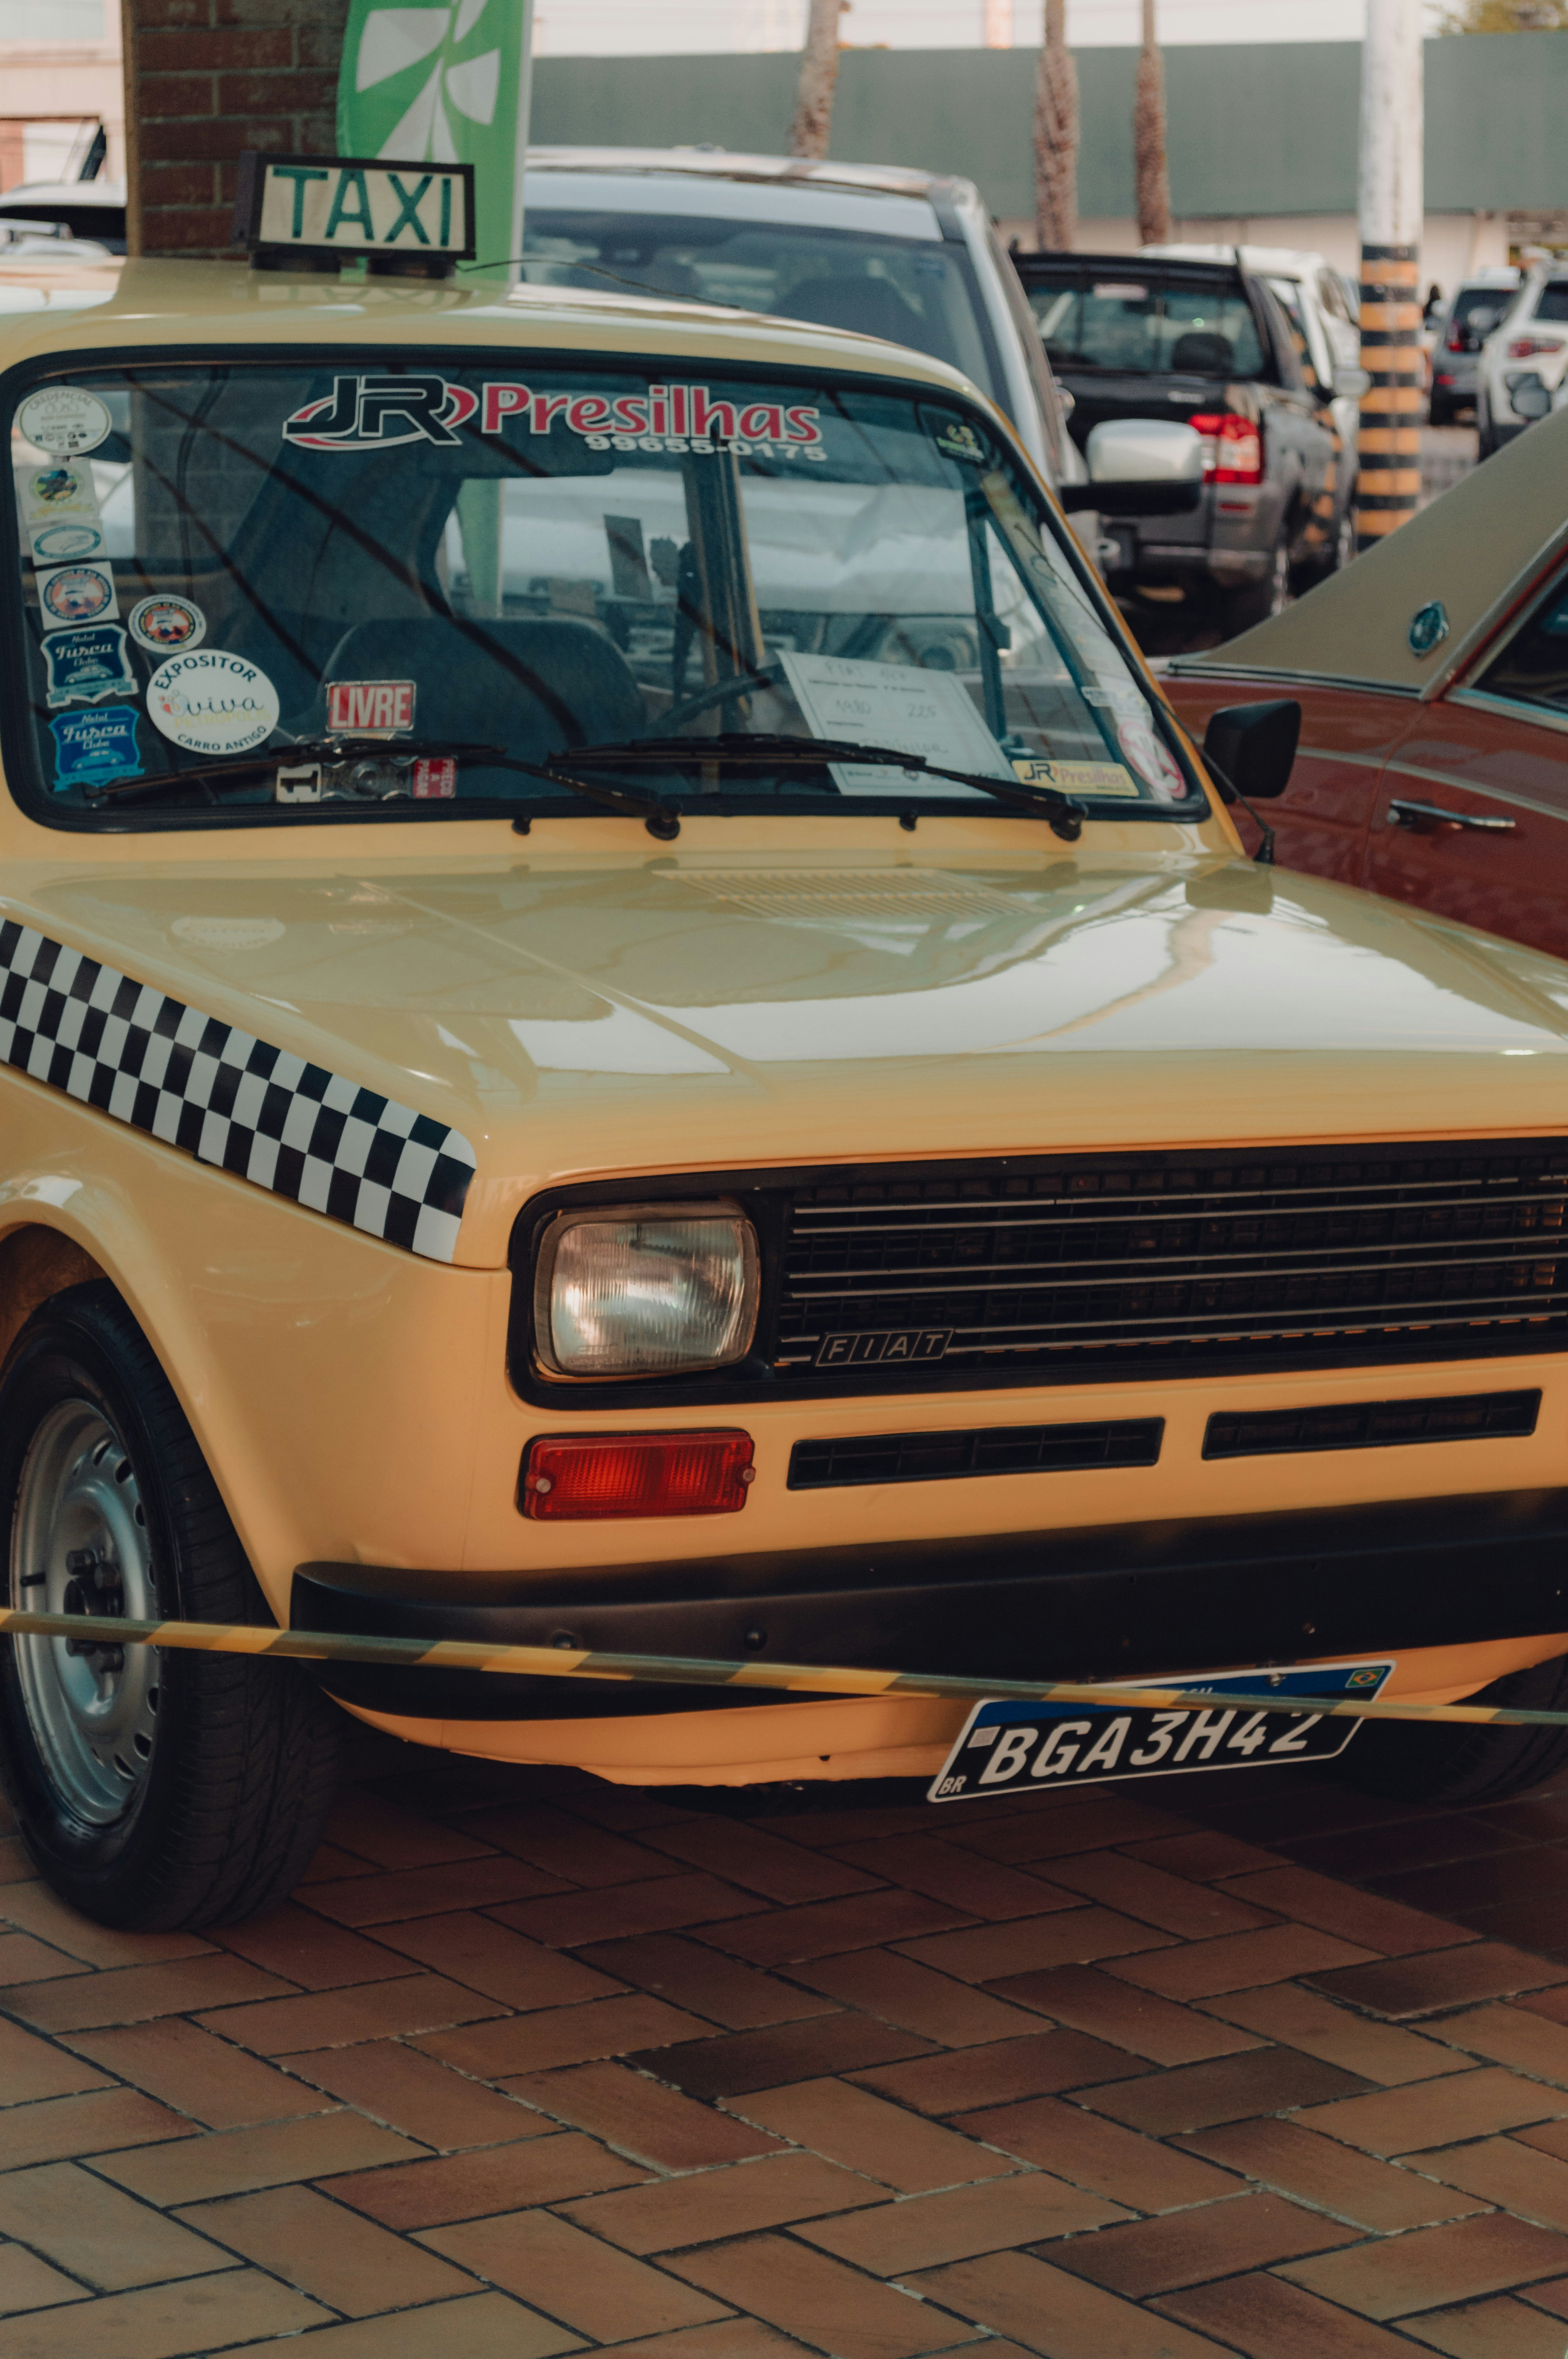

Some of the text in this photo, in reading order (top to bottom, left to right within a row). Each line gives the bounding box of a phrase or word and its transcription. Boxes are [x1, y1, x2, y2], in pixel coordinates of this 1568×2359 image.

[273, 166, 451, 247] TAXI
[282, 374, 823, 445] JR Presilhas
[584, 434, 828, 462] 99655-0175
[154, 655, 256, 689] EXPOSITOR
[187, 697, 265, 716] viva
[331, 687, 411, 727] LIVRE
[178, 725, 267, 751] CARRO ANTIGO
[1024, 763, 1056, 783] JR
[828, 1334, 944, 1360] FIAT
[978, 1708, 1324, 1785] BGA3H42
[938, 1775, 967, 1795] BR
